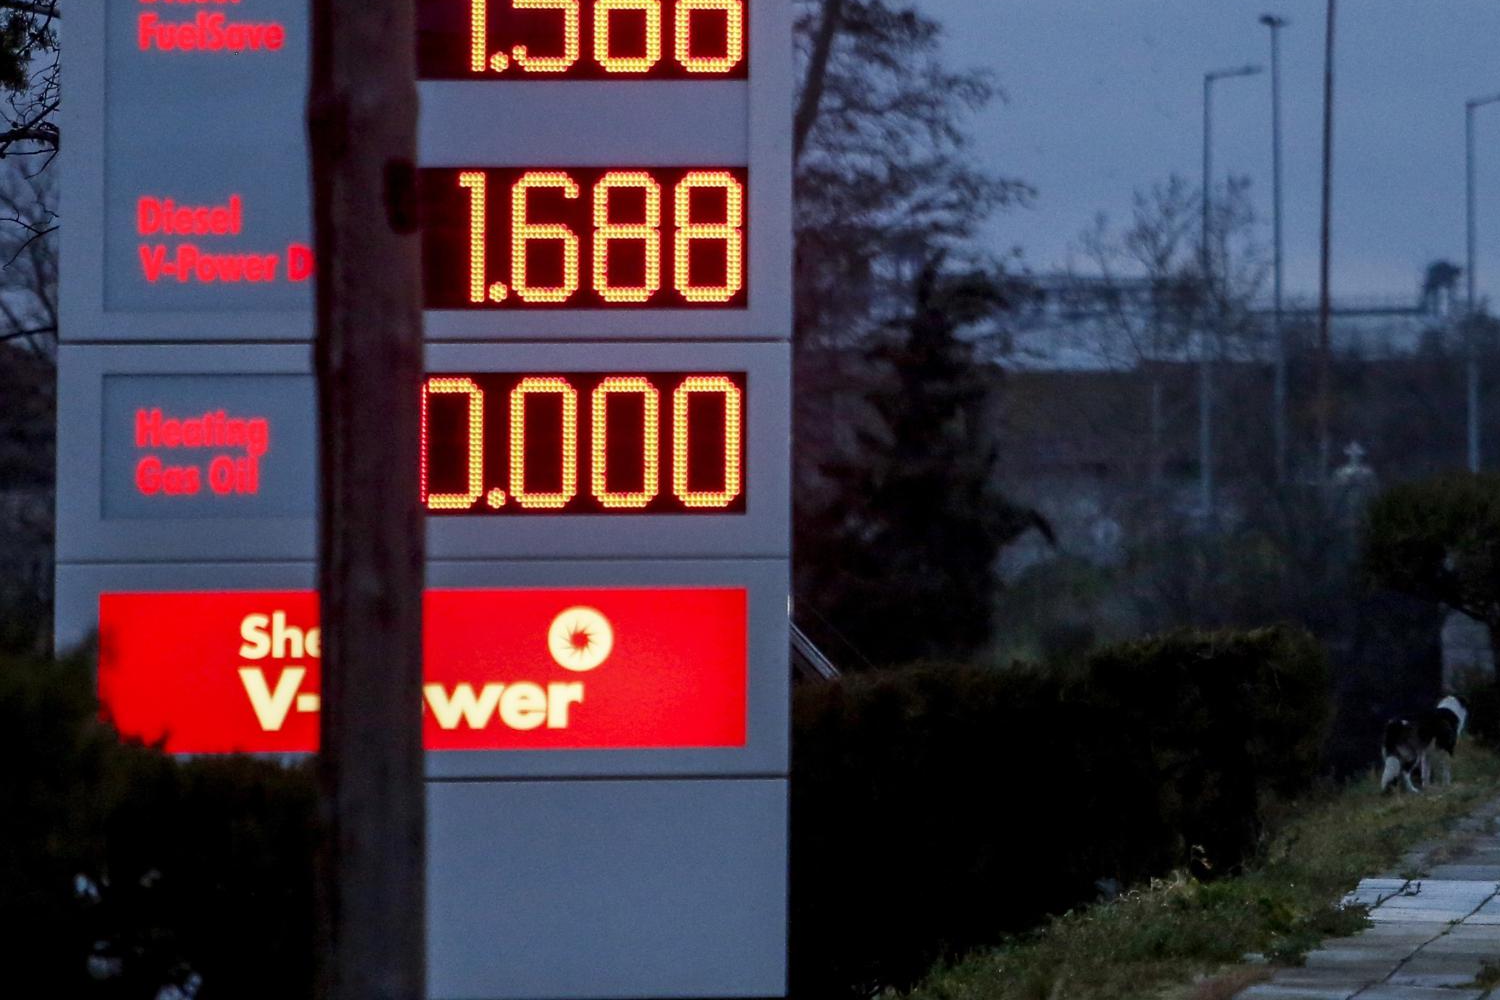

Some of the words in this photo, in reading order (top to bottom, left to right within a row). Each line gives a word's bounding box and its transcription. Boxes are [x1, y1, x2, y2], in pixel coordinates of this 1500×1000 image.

[138, 11, 286, 51] FuelSave
[137, 194, 241, 236] Diesel
[458, 172, 743, 303] 1.688
[139, 244, 279, 282] V-Power
[135, 408, 270, 456] Heating
[421, 377, 741, 509] 0.000
[135, 455, 201, 495] Gas
[208, 454, 260, 494] Oil
[239, 610, 321, 660] She
[238, 666, 584, 731] V-wer
